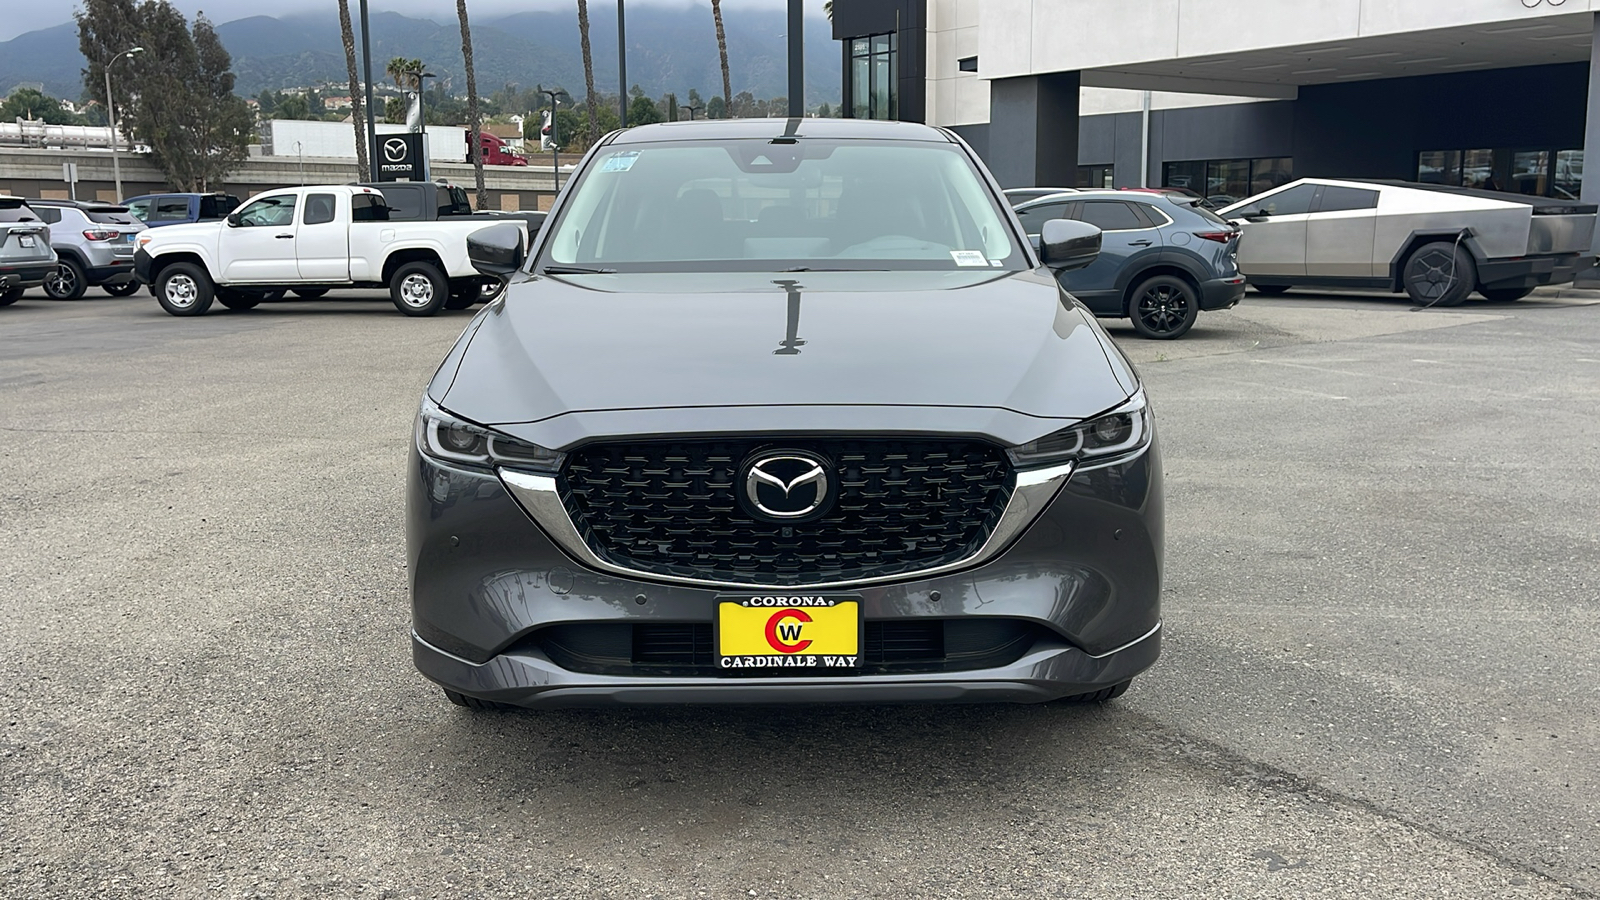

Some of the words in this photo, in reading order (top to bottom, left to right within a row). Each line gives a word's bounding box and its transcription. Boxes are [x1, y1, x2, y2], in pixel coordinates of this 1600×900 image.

[750, 596, 827, 606] CORONA
[720, 656, 817, 668] CARDINALE
[823, 656, 858, 667] WAY
